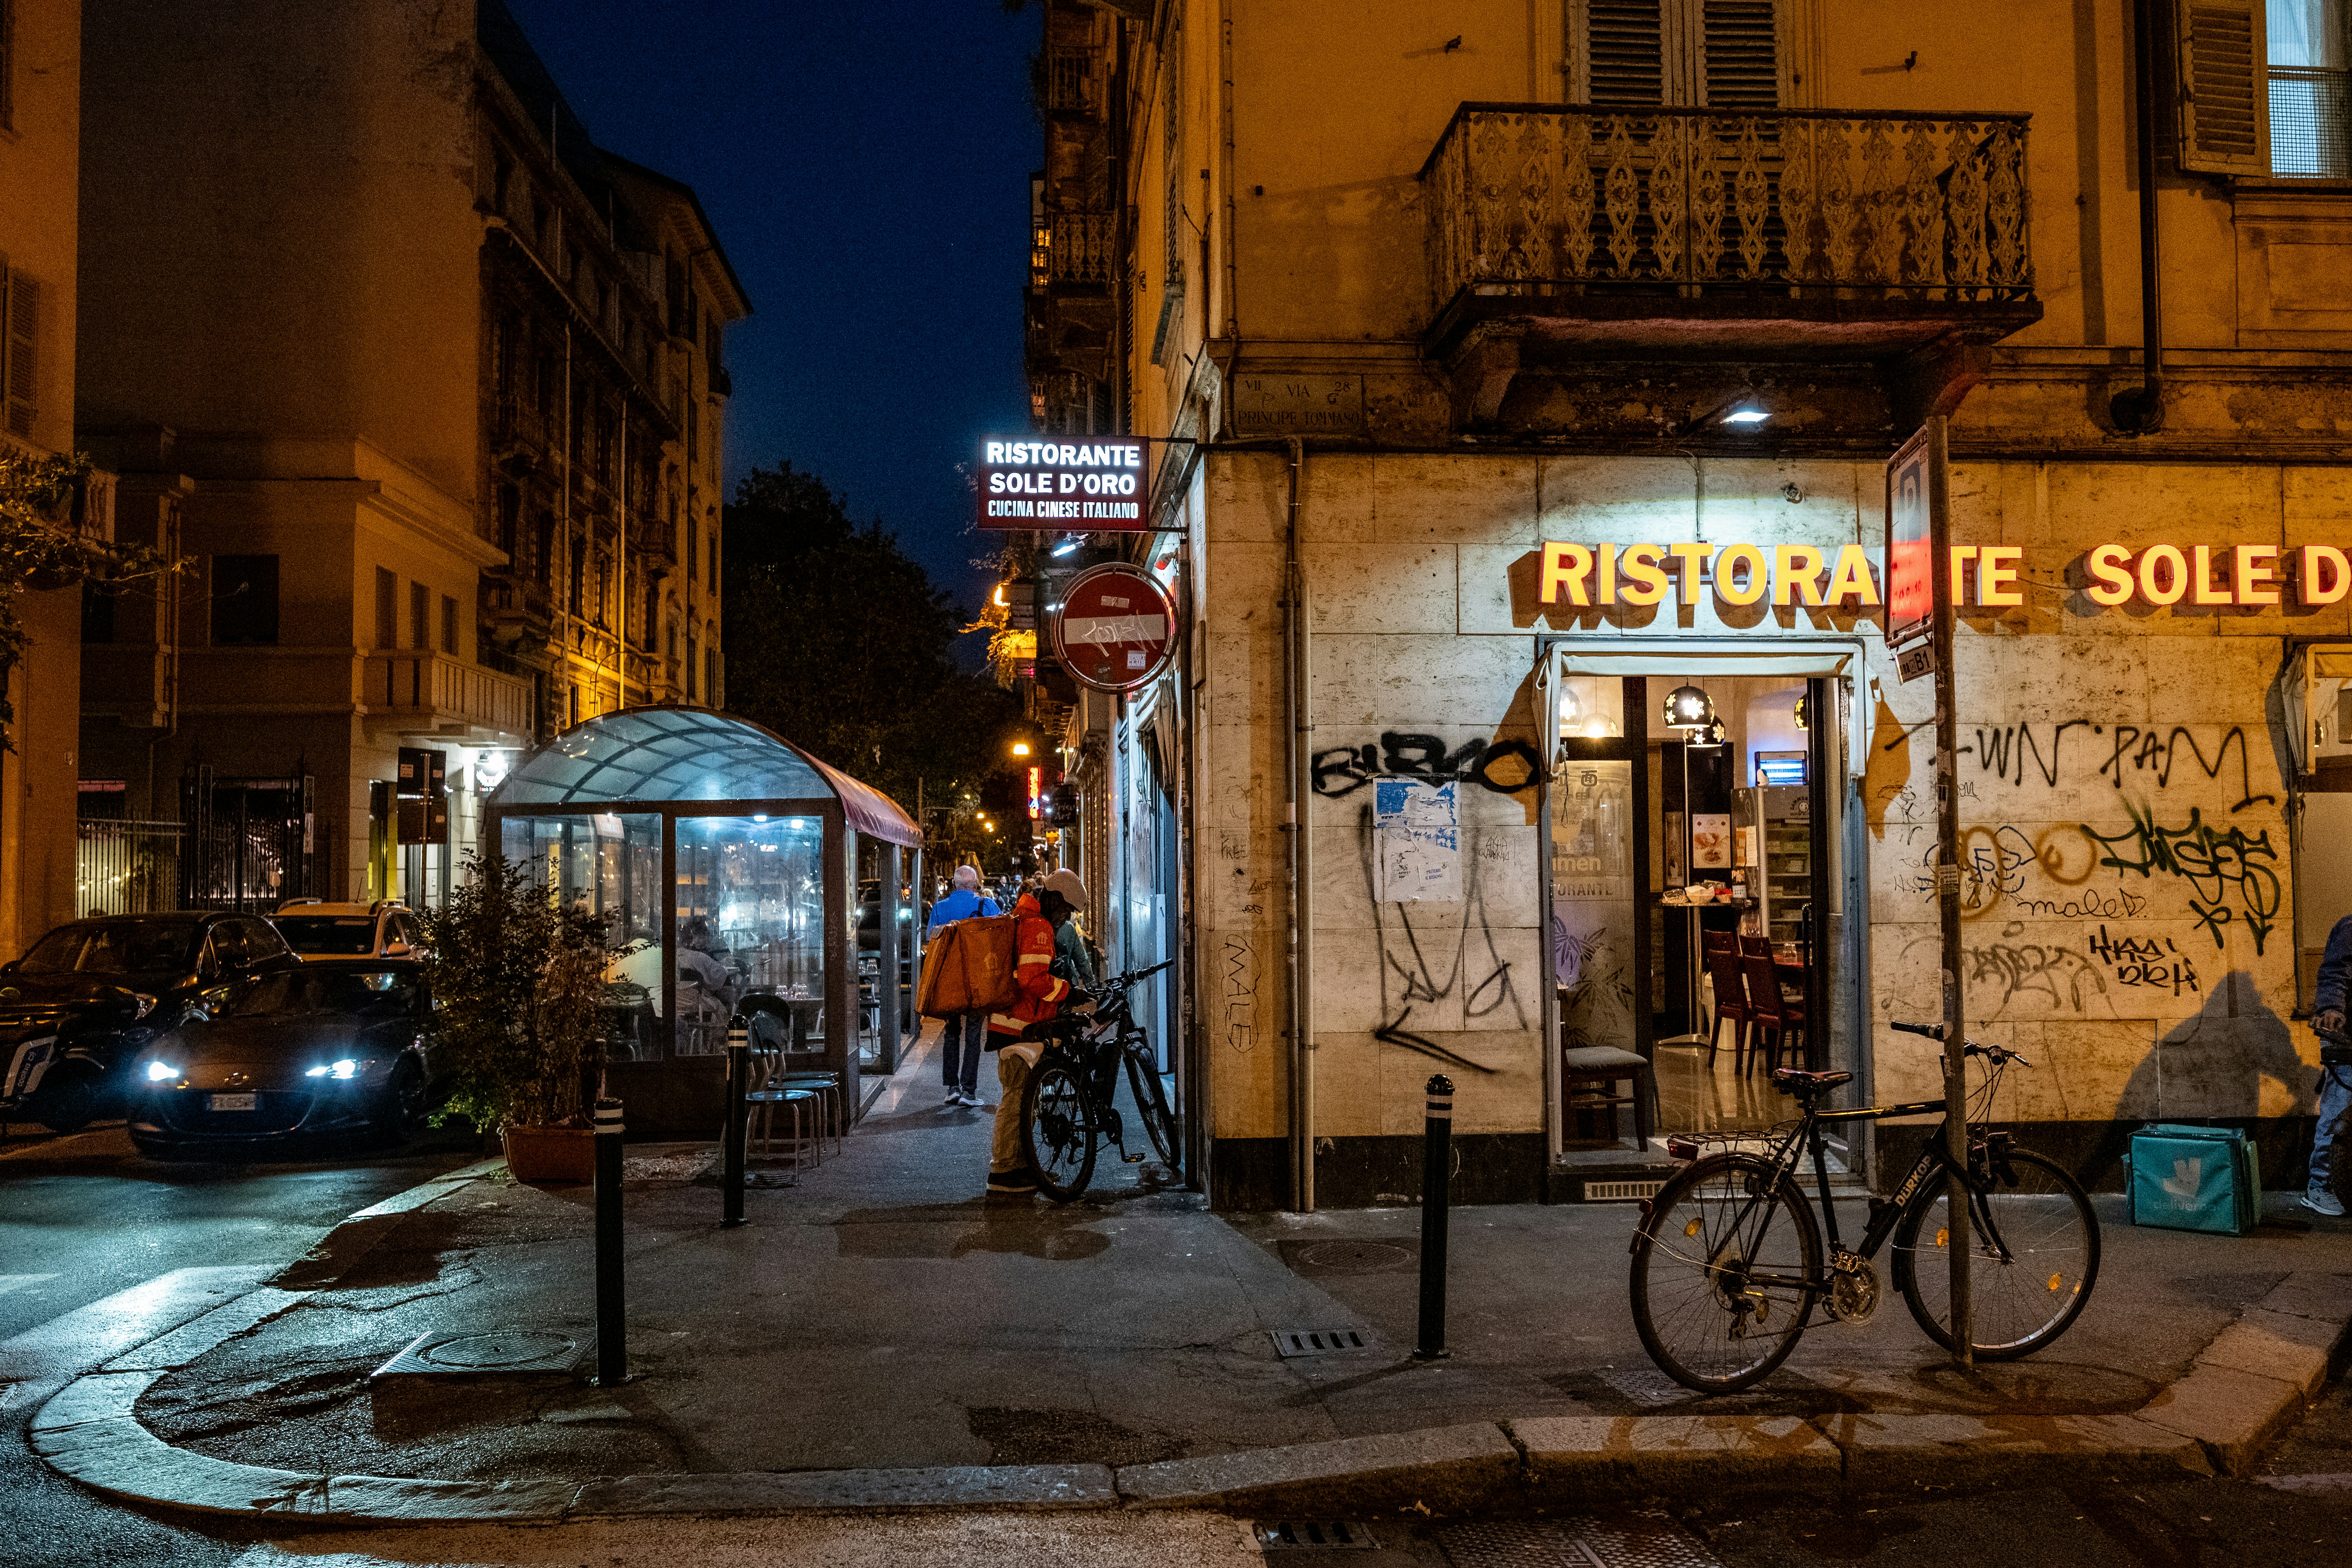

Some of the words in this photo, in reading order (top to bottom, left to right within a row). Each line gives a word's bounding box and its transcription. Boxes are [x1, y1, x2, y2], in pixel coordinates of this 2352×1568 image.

[1287, 384, 1310, 398] VIA
[1238, 411, 1296, 425] PRINCIPE
[1305, 411, 1360, 425] TOMMASO
[987, 442, 1140, 467] RISTORANTE
[989, 472, 1053, 494] SOLE
[1059, 473, 1136, 495] D'ORO
[988, 500, 1034, 517] CUCINA
[1037, 501, 1080, 518] CINESE
[1083, 502, 1139, 520] ITALIANO
[1540, 541, 2023, 606] RISTORATE
[2088, 543, 2279, 606] SOLE
[1914, 649, 1931, 671] B1
